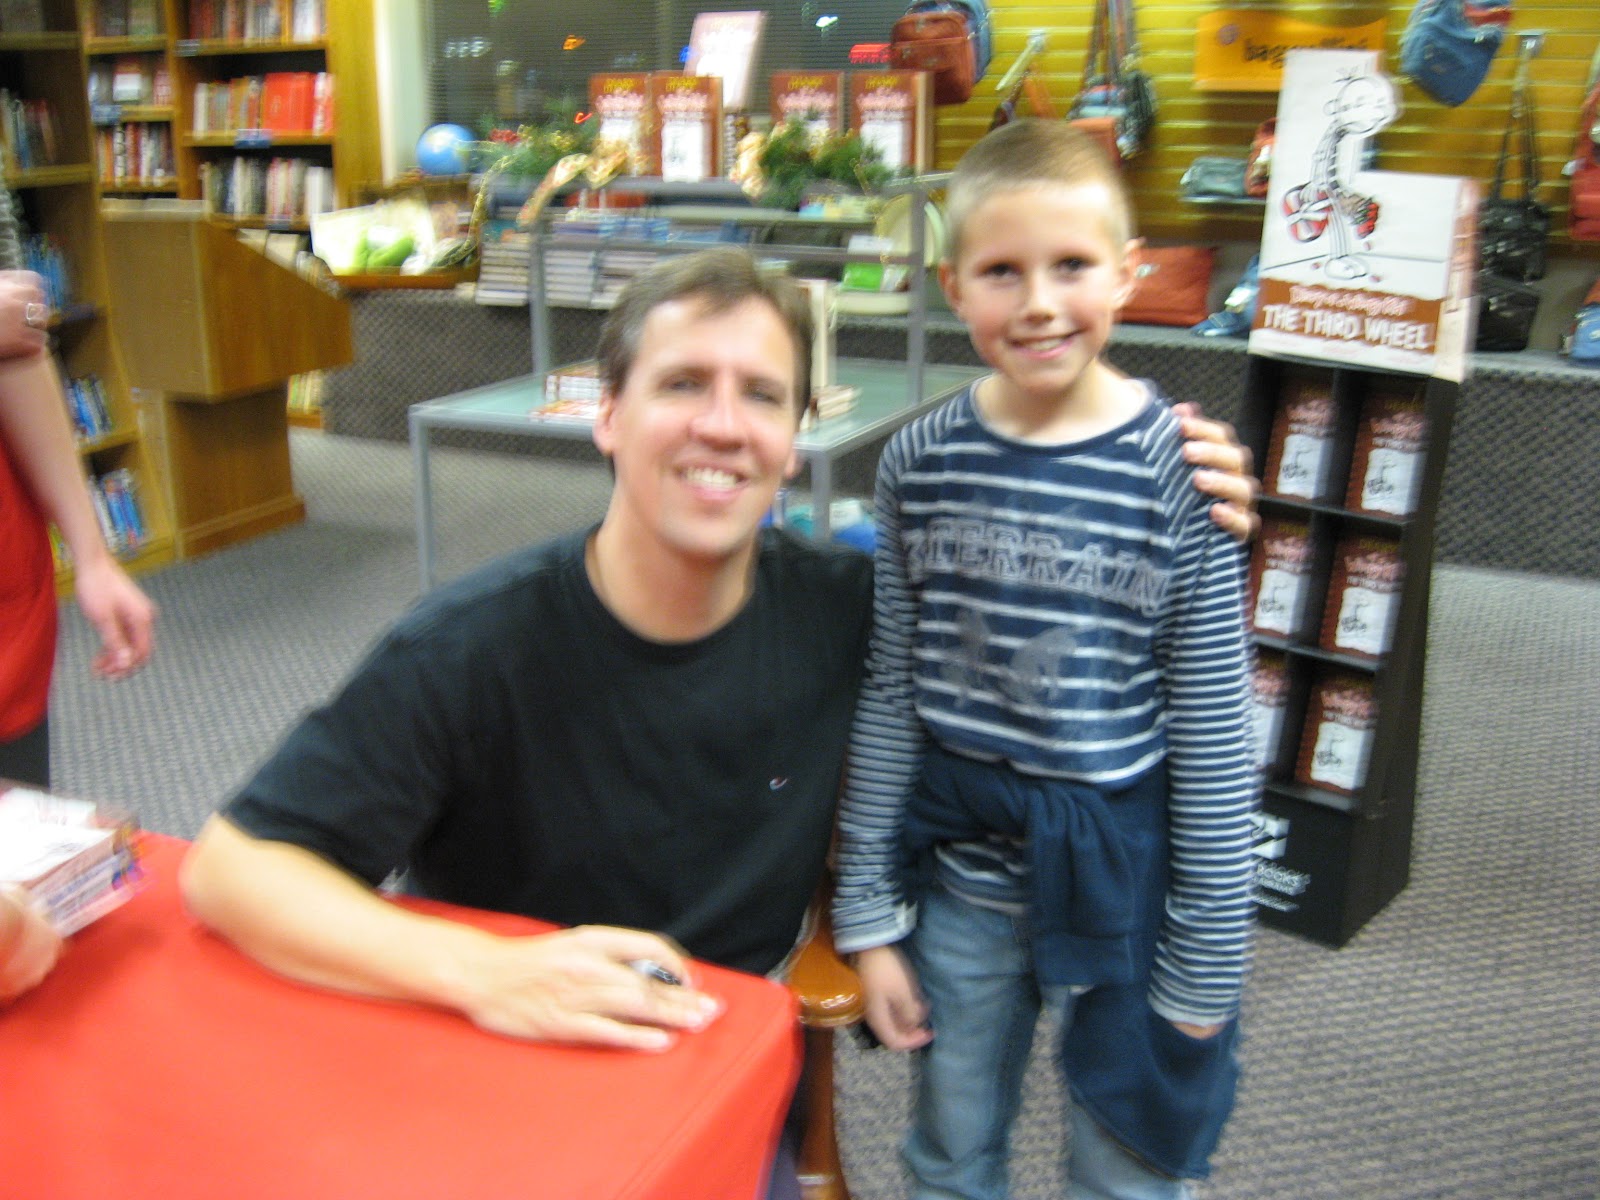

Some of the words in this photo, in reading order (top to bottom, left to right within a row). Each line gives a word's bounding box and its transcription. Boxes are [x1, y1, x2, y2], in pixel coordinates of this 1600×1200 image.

[1262, 303, 1300, 332] THE
[1302, 308, 1362, 341] THIRD
[1364, 315, 1432, 351] WHEEL
